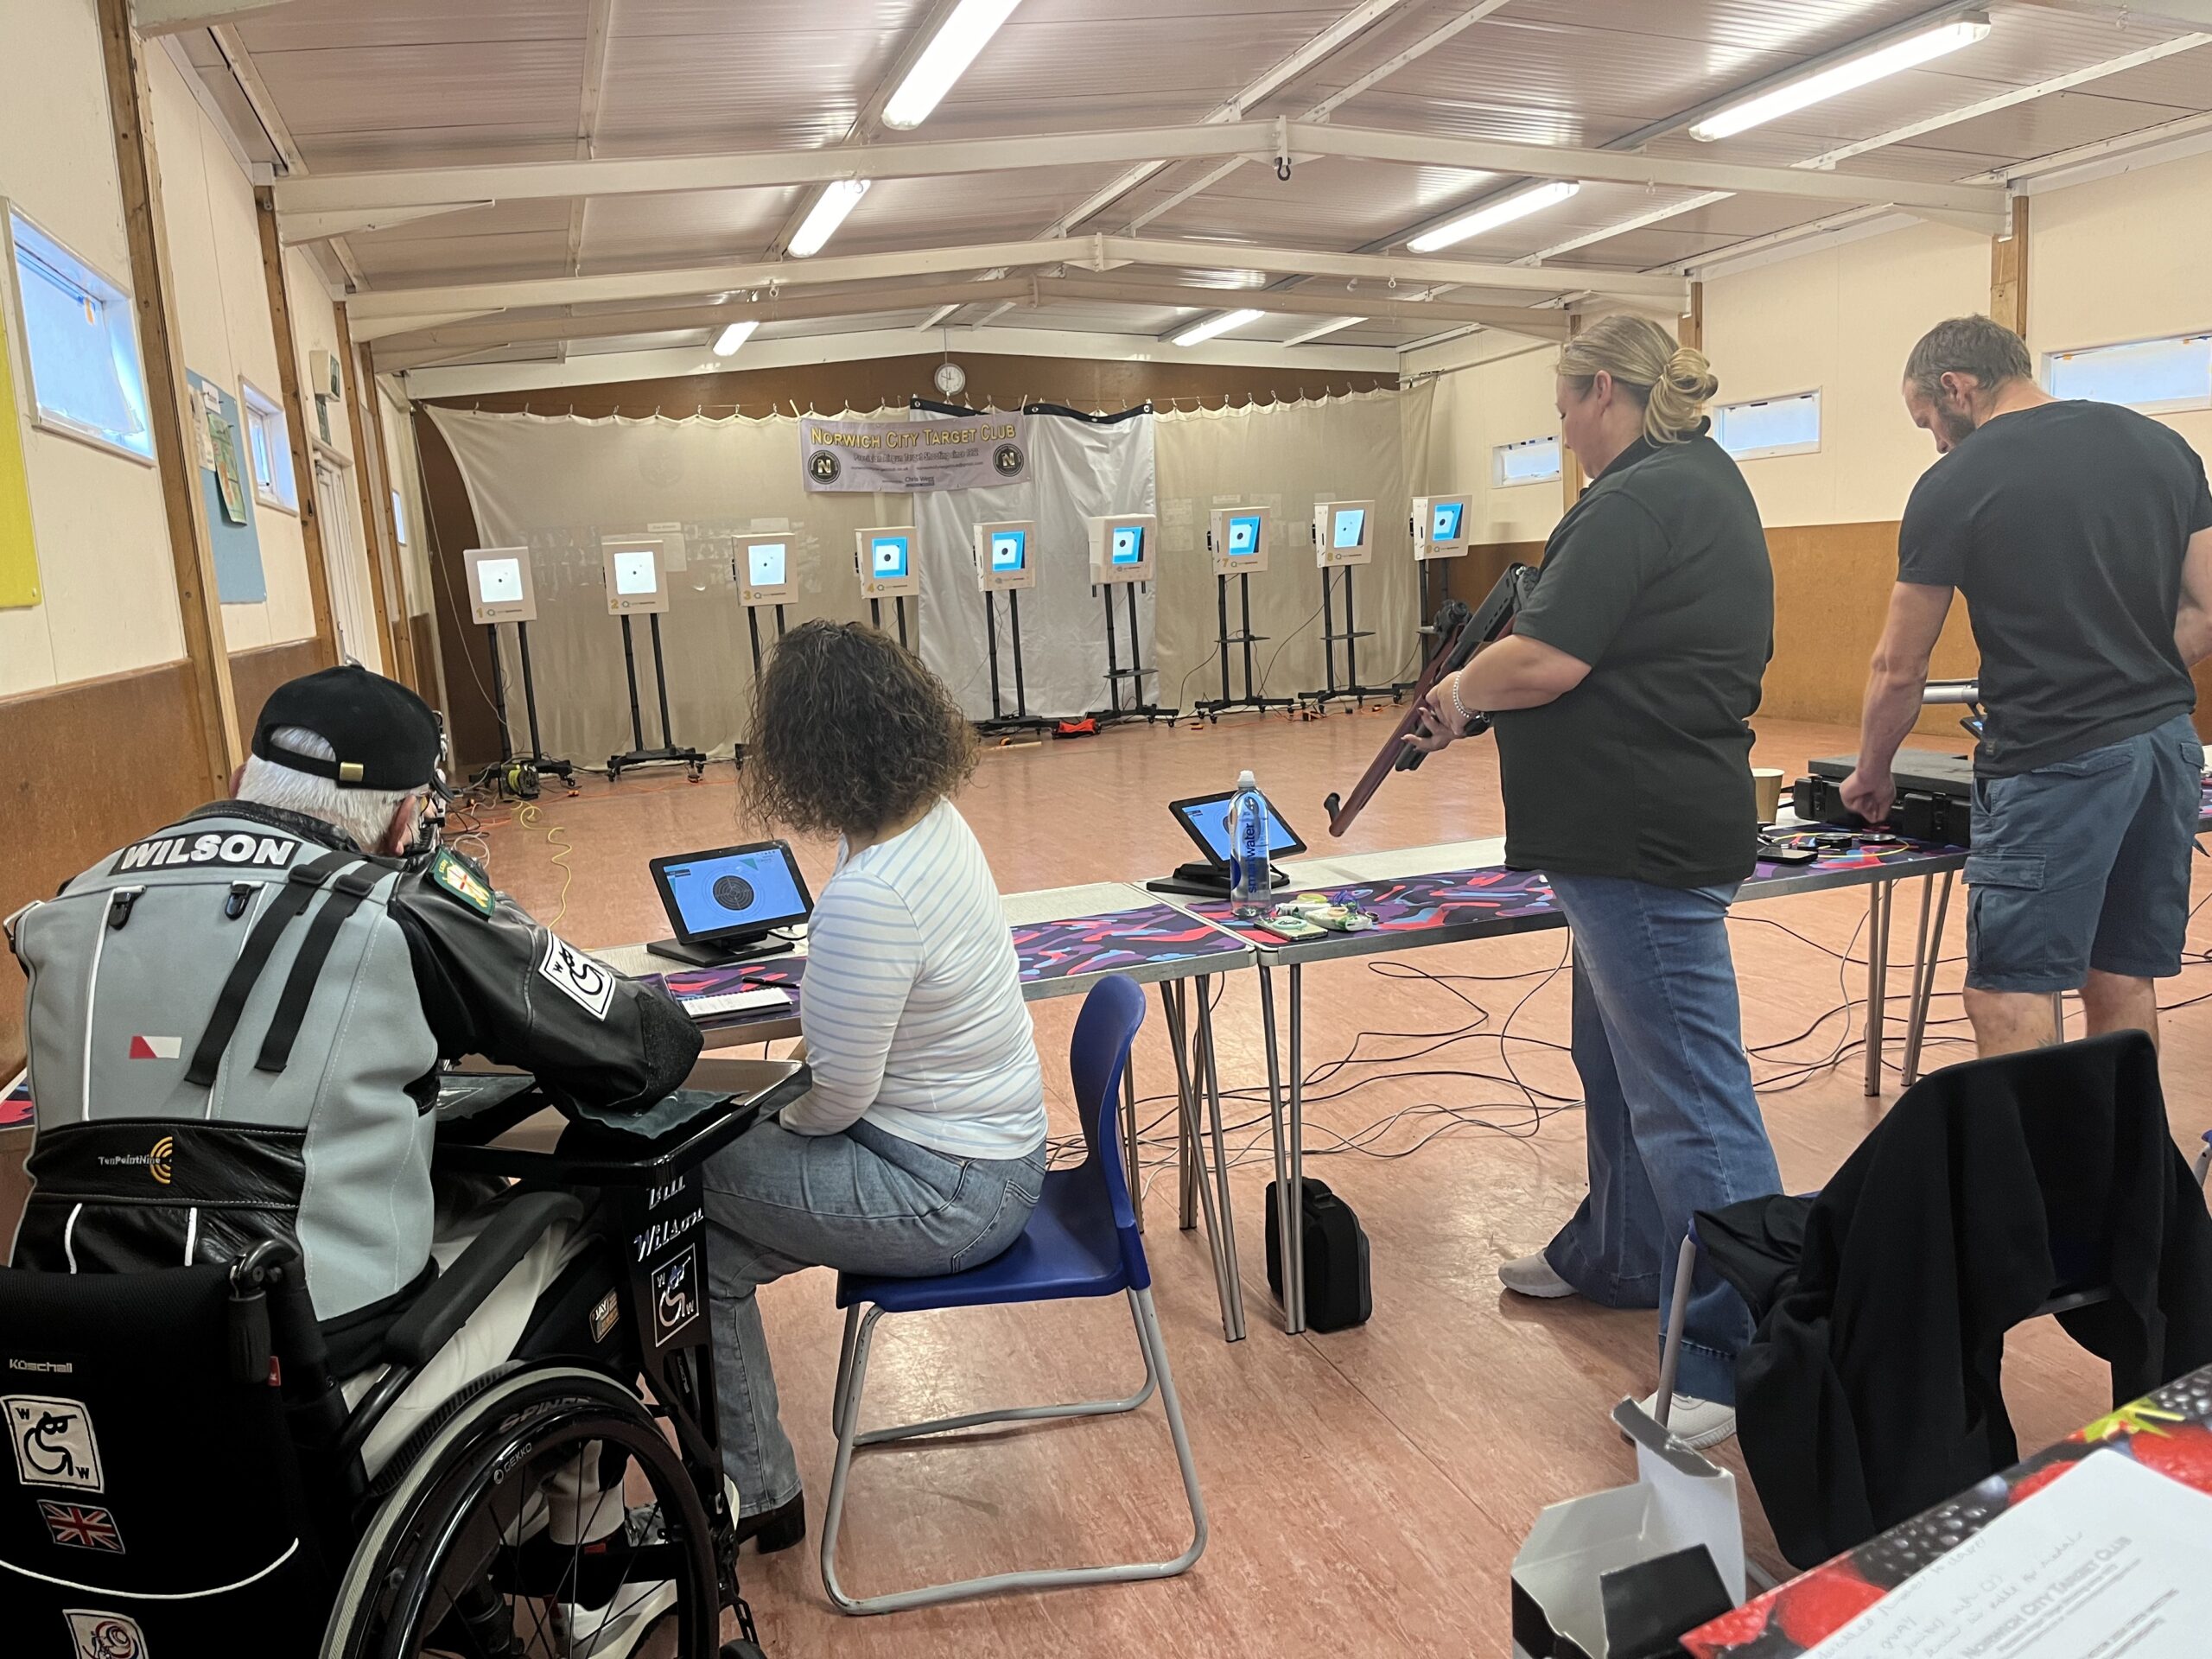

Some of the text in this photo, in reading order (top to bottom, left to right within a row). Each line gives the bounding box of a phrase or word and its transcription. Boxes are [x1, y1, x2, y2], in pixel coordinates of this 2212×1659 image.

[810, 424, 1016, 448] NORWICH CITY TARGET CLUB
[743, 590, 751, 601] 3
[867, 583, 874, 593] 4
[476, 607, 483, 619] 1
[610, 599, 619, 609] 2
[120, 834, 296, 870] WILSON
[1244, 823, 1257, 893] smartwater
[98, 1154, 161, 1166] TenPointNine
[633, 1207, 704, 1262] Wilson
[504, 1442, 532, 1472] GEKKO
